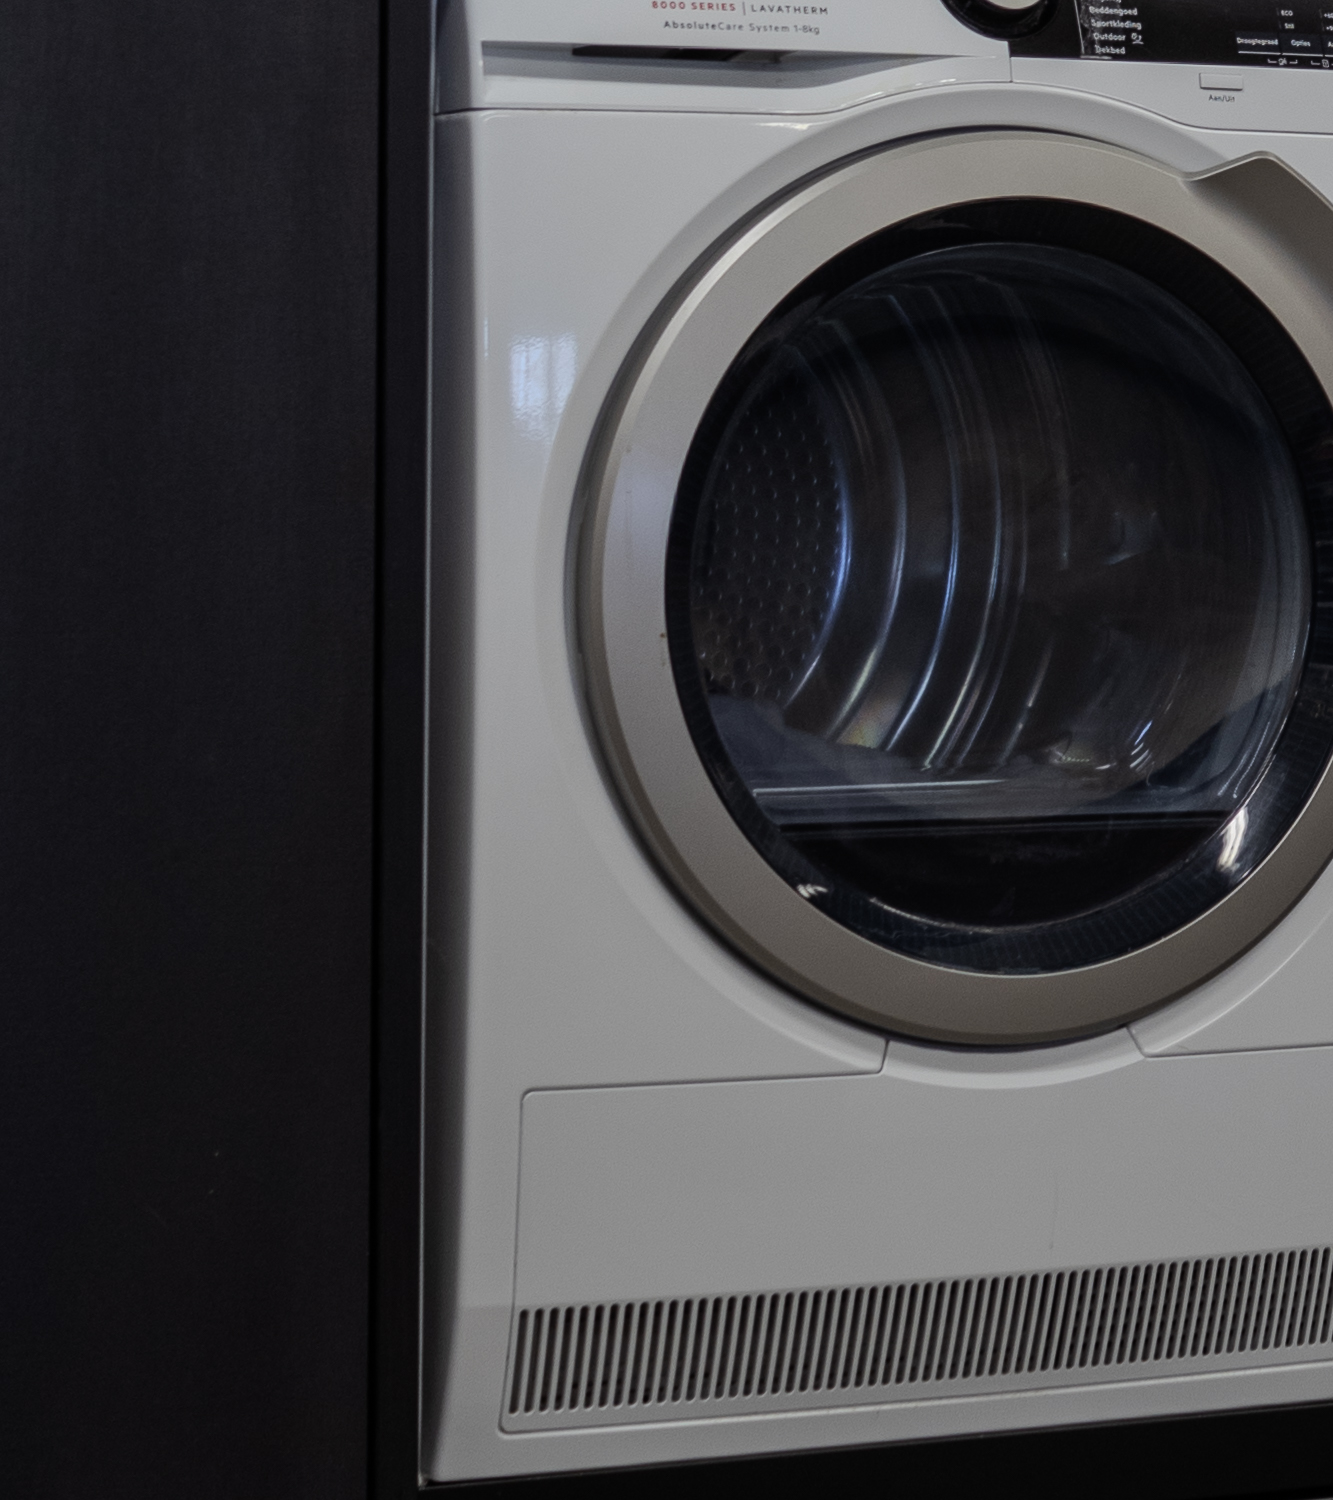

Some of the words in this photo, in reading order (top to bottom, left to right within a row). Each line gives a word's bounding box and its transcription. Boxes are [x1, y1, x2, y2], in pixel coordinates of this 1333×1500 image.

[652, 0, 686, 10] 8000
[691, 2, 736, 12] SERIES
[751, 4, 828, 15] LAVATHERM
[1089, 6, 1138, 17] Beddengoed
[663, 21, 744, 32] AbsoluteCare
[749, 23, 790, 34] System
[793, 25, 820, 35] 1-8kg
[1091, 19, 1142, 30] Sportkleding
[1093, 33, 1126, 41] Outdoor
[1094, 45, 1126, 55] Dekbed
[1208, 94, 1235, 102] Aan/Uit
